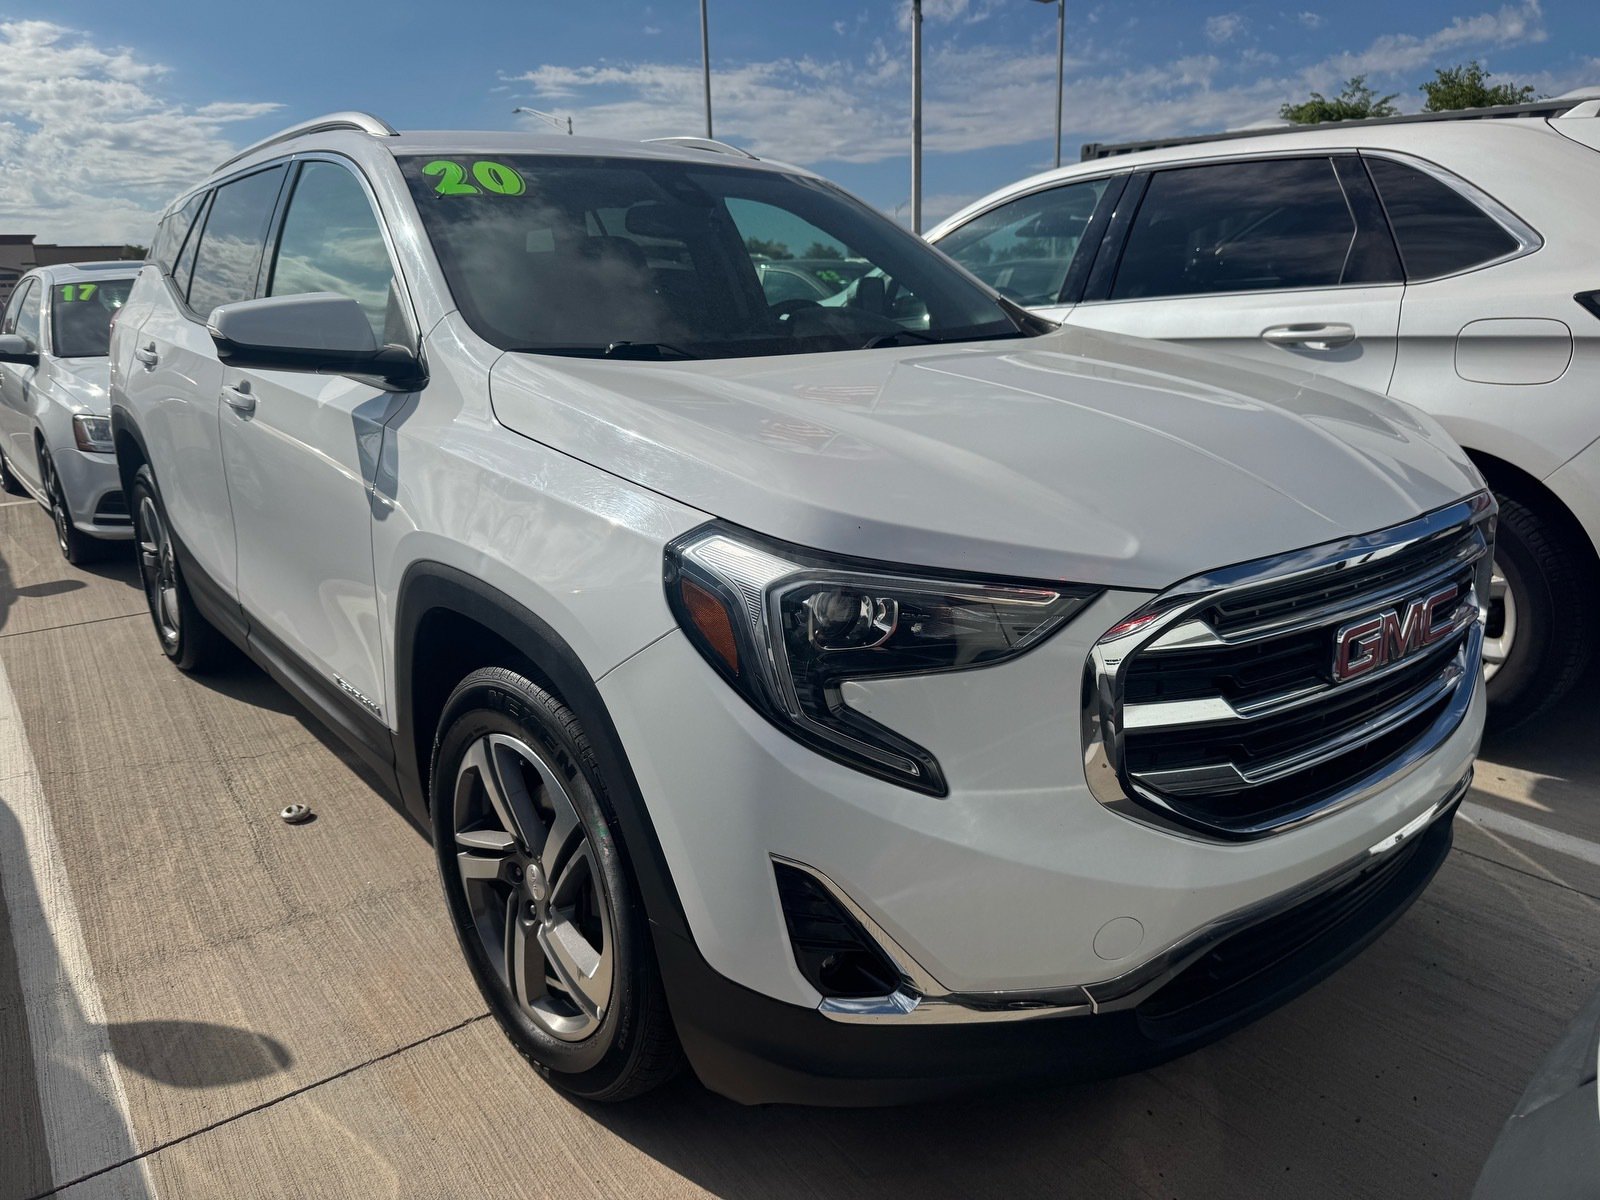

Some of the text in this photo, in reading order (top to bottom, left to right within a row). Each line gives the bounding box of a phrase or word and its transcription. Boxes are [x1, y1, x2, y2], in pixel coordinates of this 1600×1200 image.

[422, 160, 526, 196] 20
[61, 284, 97, 302] 17
[1332, 582, 1458, 683] GMC
